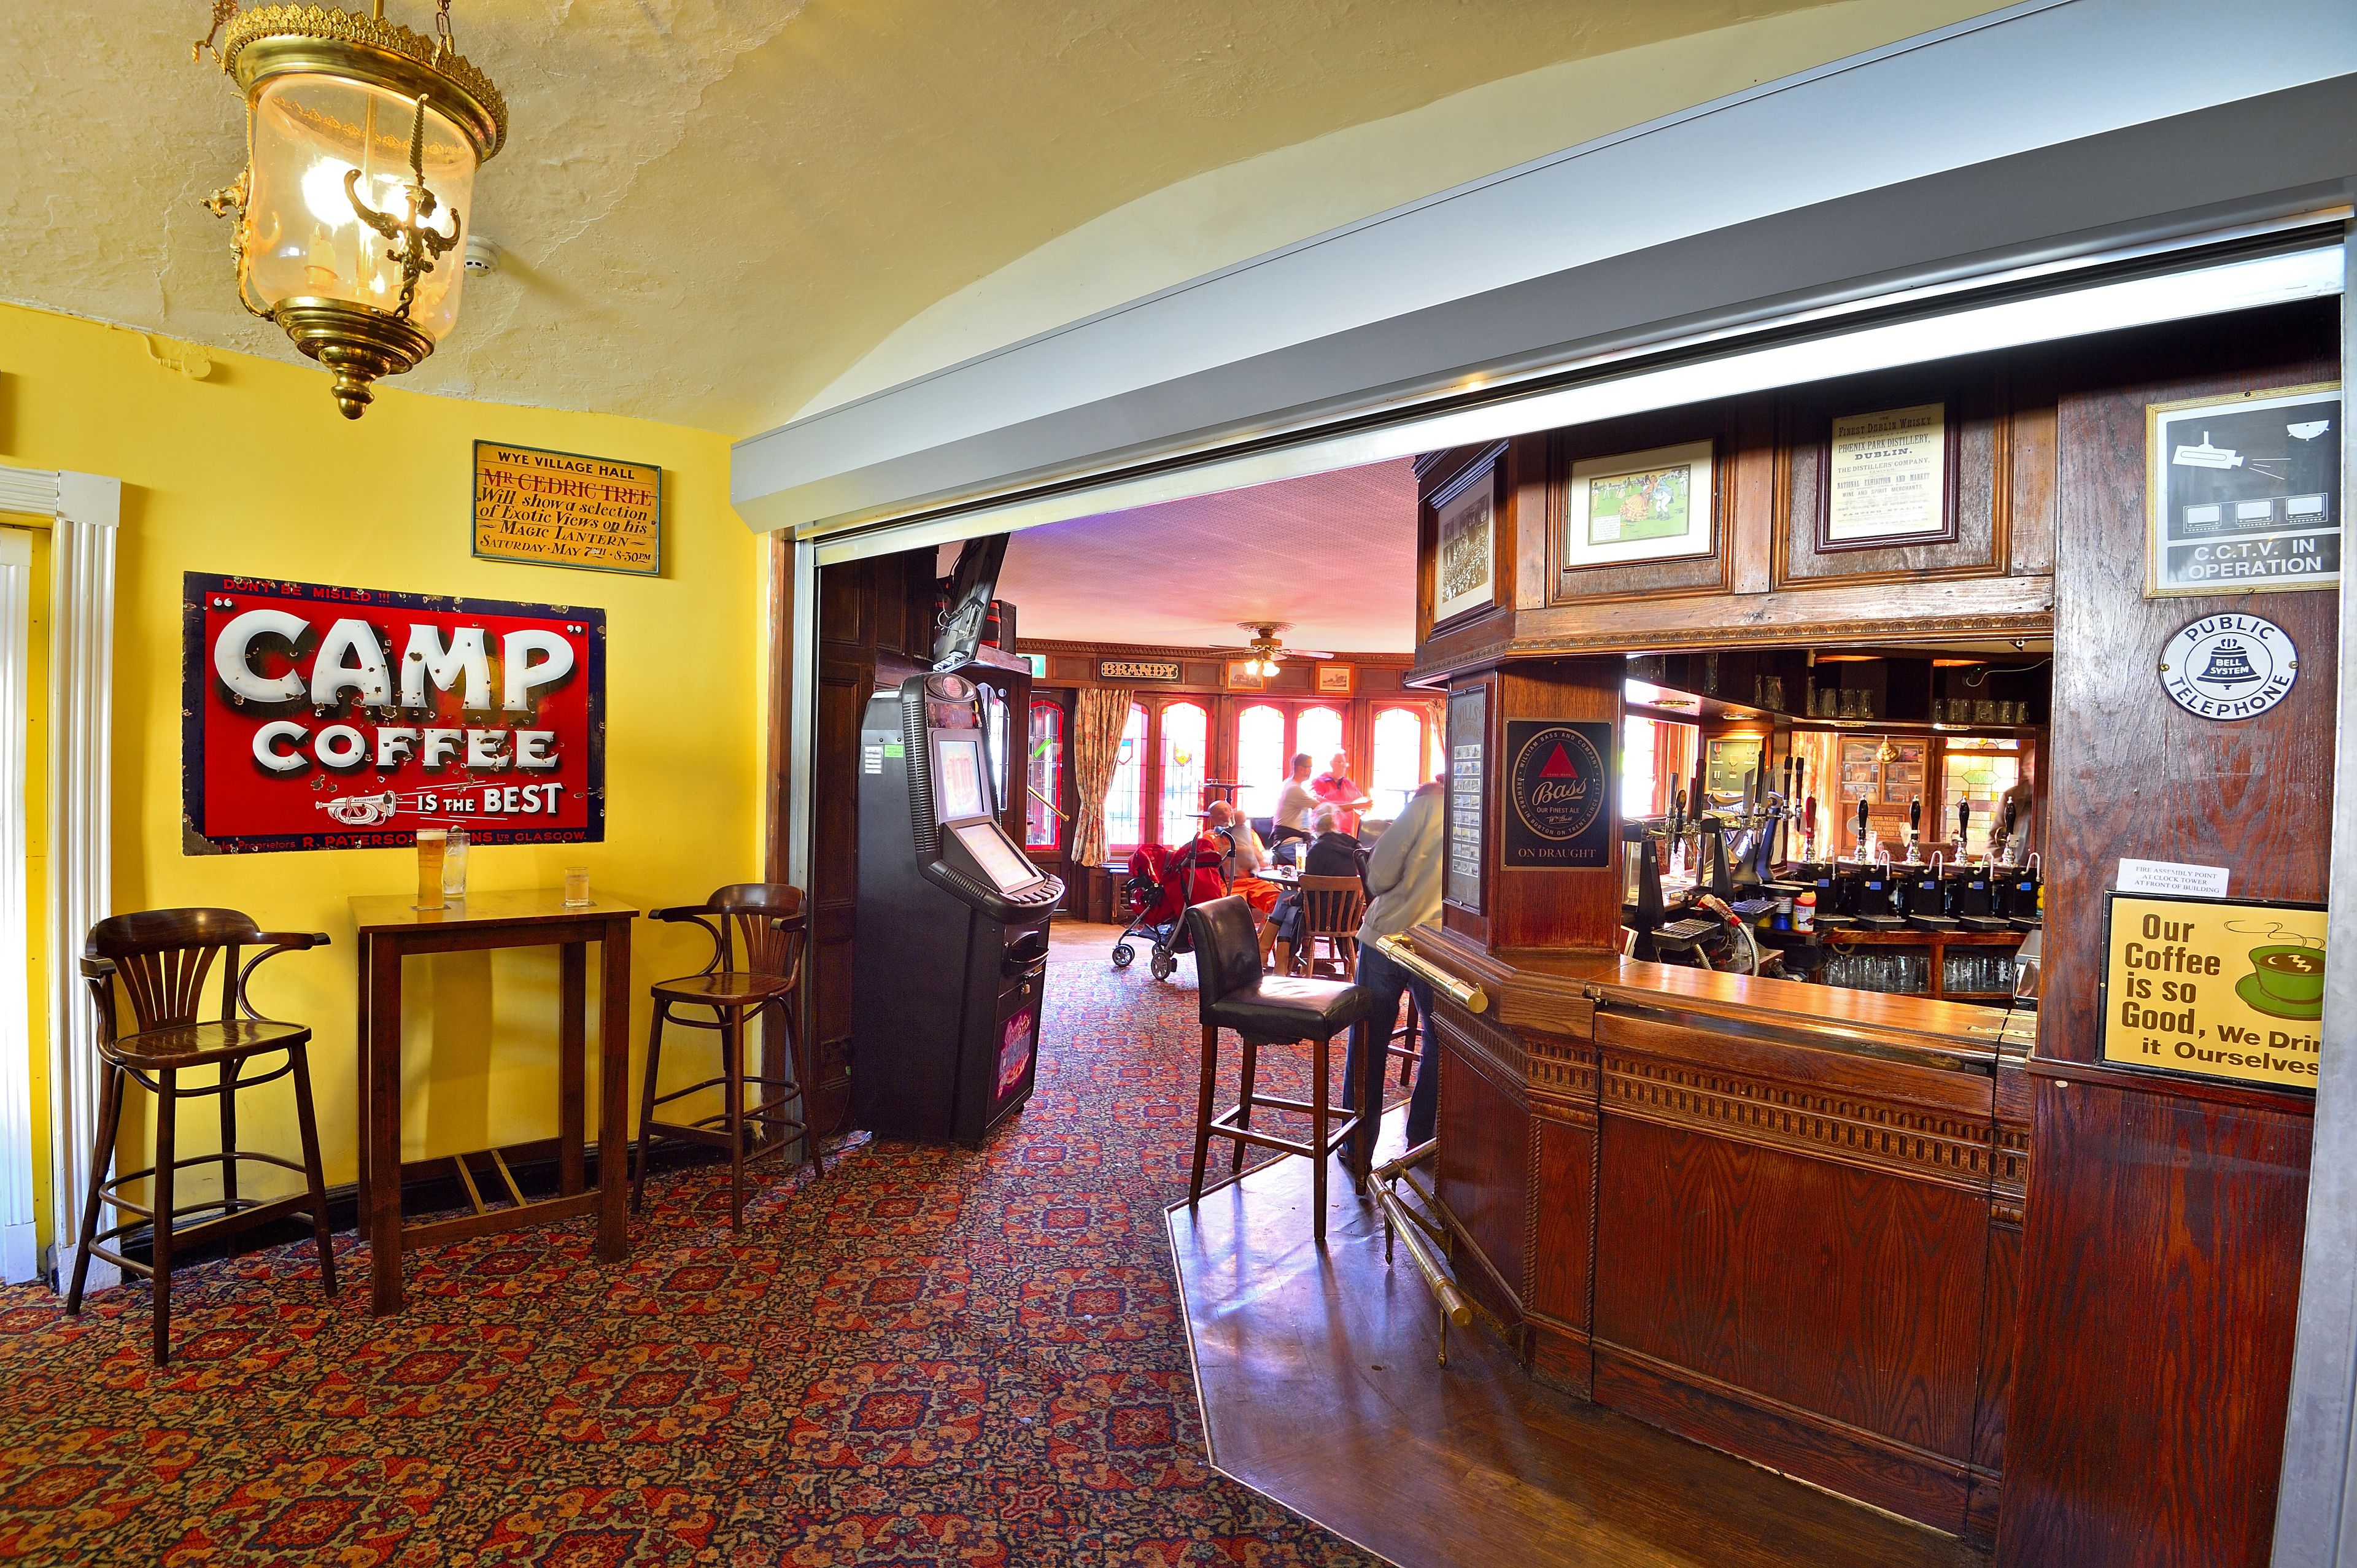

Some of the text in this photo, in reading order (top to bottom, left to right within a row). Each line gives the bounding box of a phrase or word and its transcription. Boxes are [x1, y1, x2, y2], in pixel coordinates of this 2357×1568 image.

[1838, 417, 1931, 437] FINEST DUBLIN WHISKY
[1855, 448, 1913, 460] DUBLIN.
[1868, 439, 1886, 449] PARK
[1887, 433, 1930, 447] DISTILLERY,
[498, 452, 635, 479] WYE VILLAGE HALL
[518, 473, 597, 499] CEDRIC
[601, 484, 651, 506] TREE
[1837, 481, 1860, 489] NATIONAL
[1865, 477, 1891, 486] EXHIBITION
[1910, 473, 1930, 481] MARKET
[482, 487, 648, 521] Will show a selection
[479, 504, 648, 535] of Exotic Views on his
[480, 535, 546, 552] SATURDAY
[550, 543, 581, 556] MAY
[499, 520, 630, 547] MAGIC LANTERN
[2194, 538, 2315, 561] C.C.T.V. IN
[2188, 557, 2321, 579] OPERATION
[281, 583, 302, 596] BE
[313, 587, 371, 602] MISLED
[2184, 617, 2275, 641] PUBLIC
[1104, 663, 1175, 677] BRANDY
[2210, 666, 2249, 674] SYSTEM
[2169, 674, 2290, 716] TELEPHONE
[252, 720, 559, 771] COFFEE
[1519, 742, 1539, 768] WILLIAM
[1541, 732, 1558, 742] BASS
[1578, 740, 1599, 768] COMPANY
[417, 782, 564, 814] IS THE BEST
[1532, 778, 1587, 806] Bass
[1517, 778, 1527, 808] BREWERS
[1530, 819, 1554, 835] BURTON
[1568, 819, 1587, 833] TRENT
[1586, 799, 1598, 817] SINCE
[238, 840, 295, 851] Proprietors
[1518, 848, 1596, 858] ON DRAUGHT
[2142, 913, 2195, 943] Our
[2124, 942, 2221, 976] Coffee
[2126, 971, 2197, 1004] is so
[2121, 1001, 2320, 1053] Good, We Drin
[2142, 1037, 2319, 1076] it Ourselves
